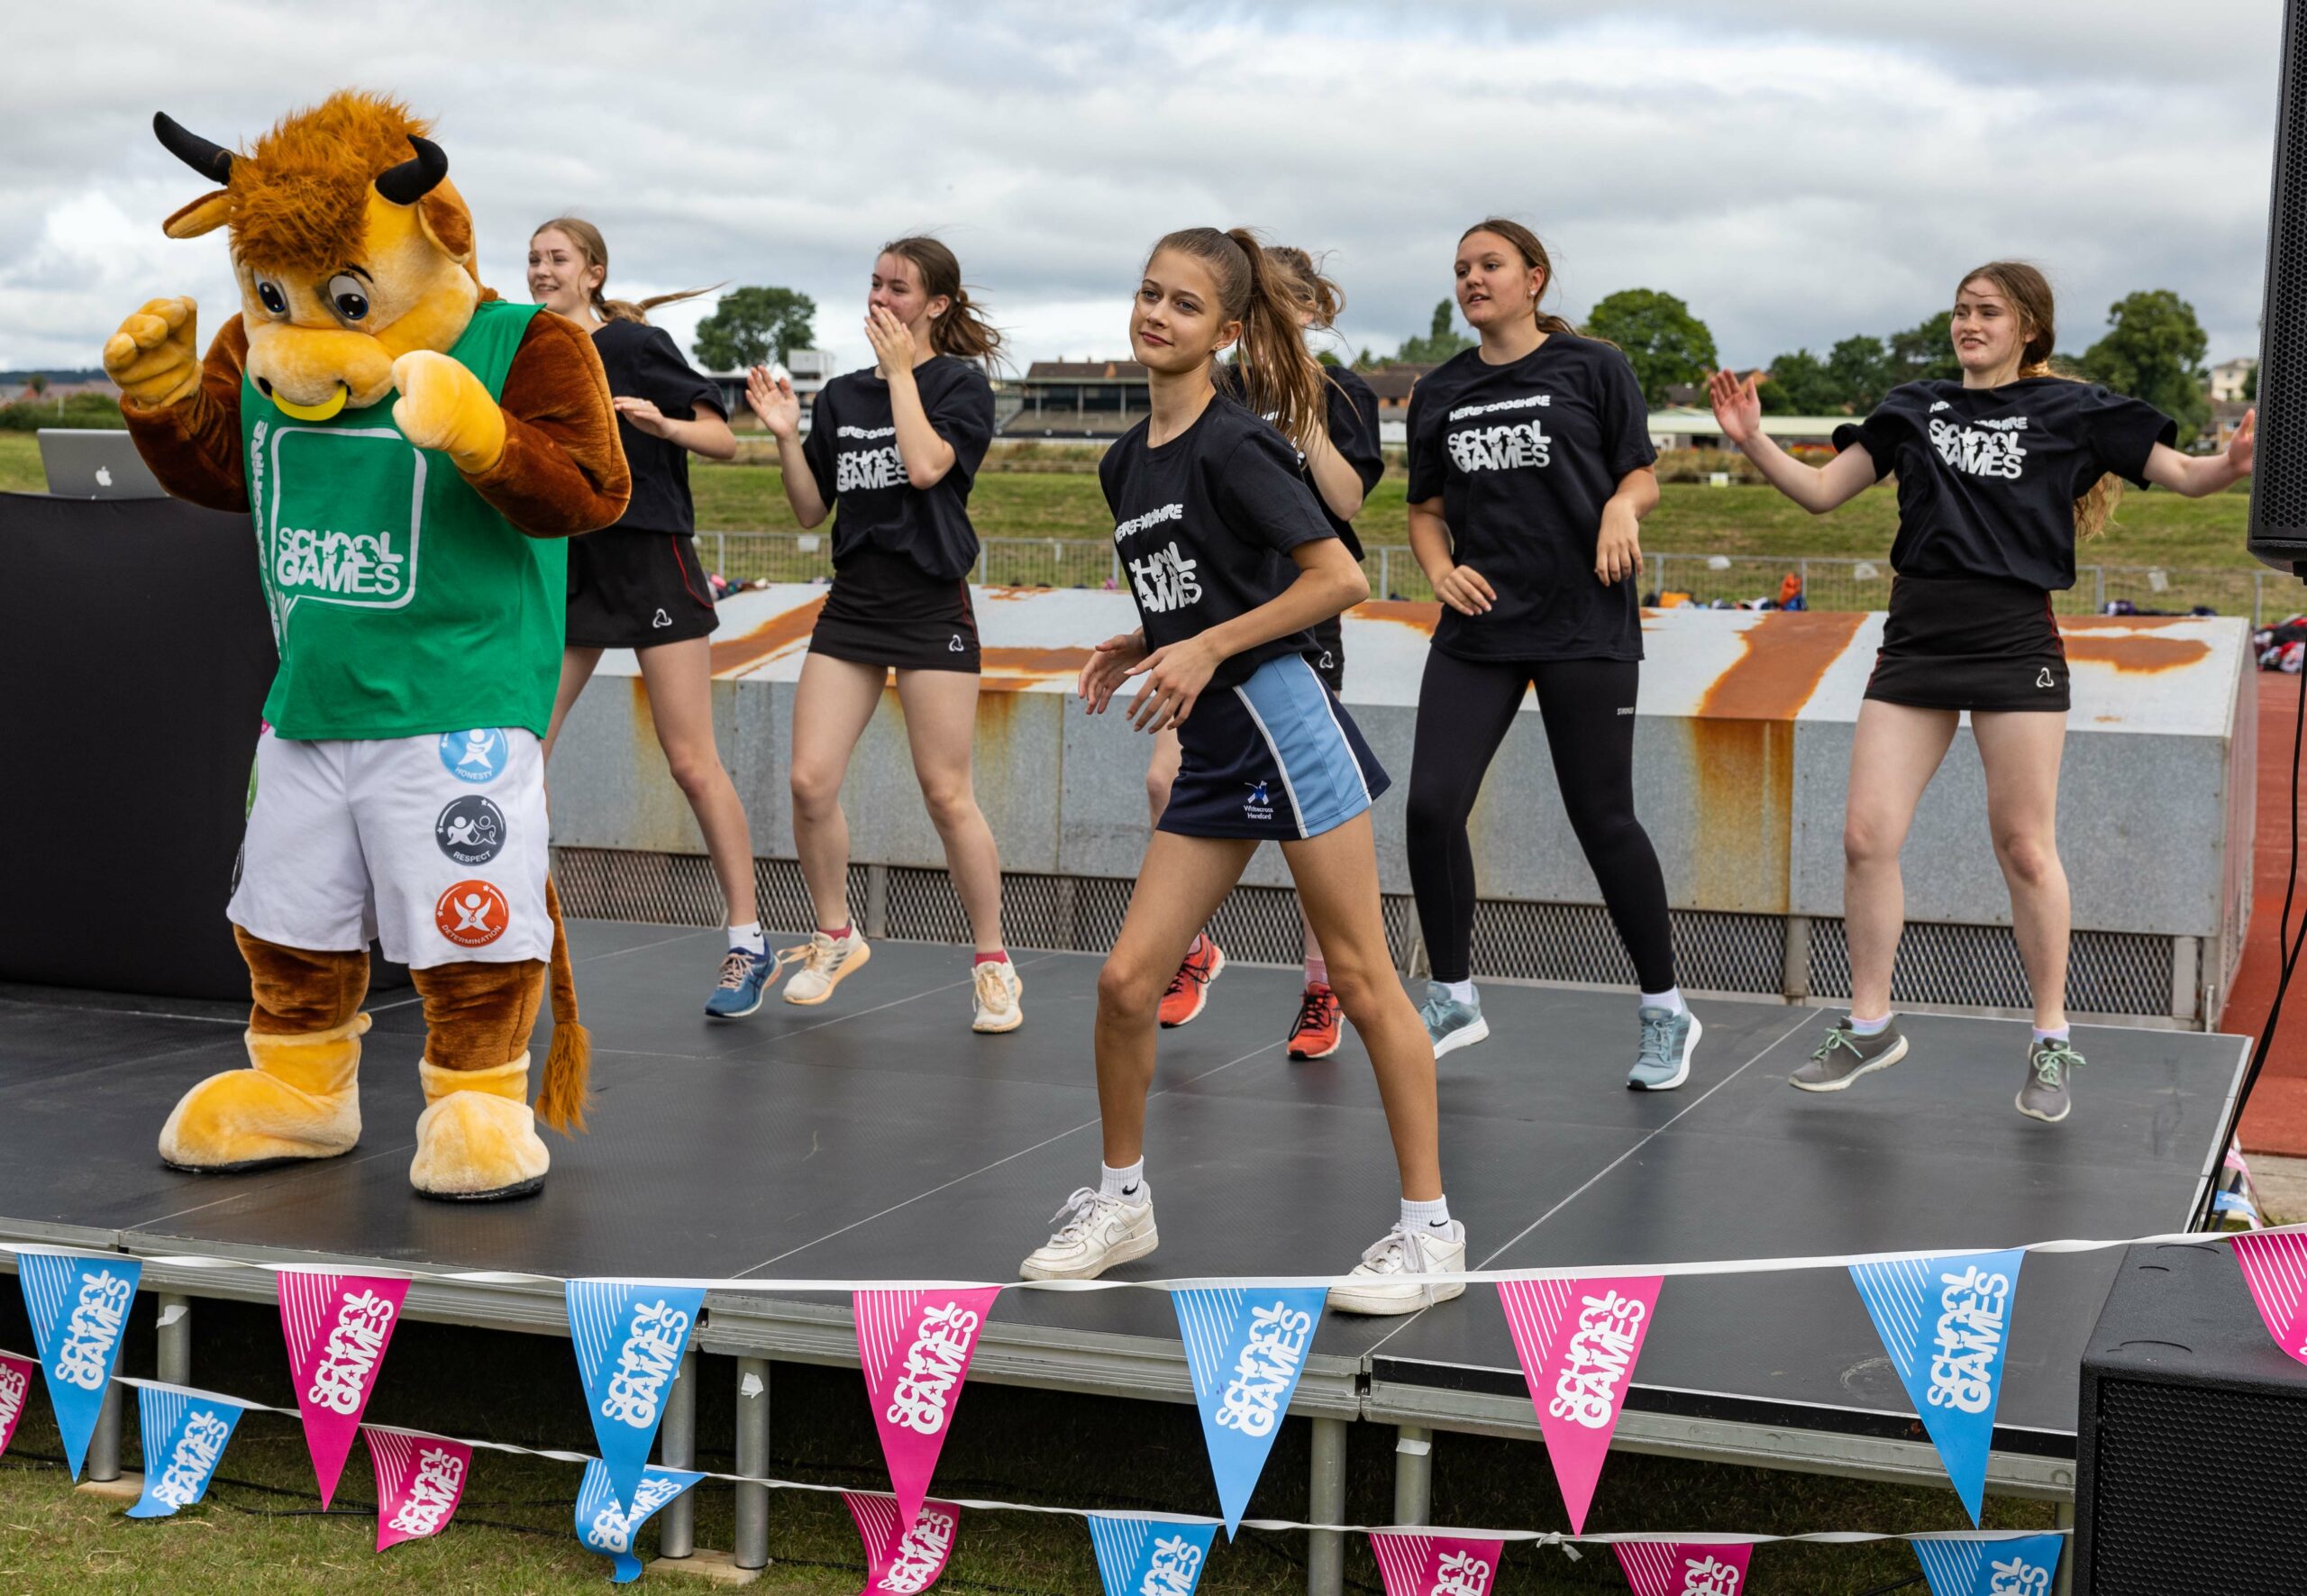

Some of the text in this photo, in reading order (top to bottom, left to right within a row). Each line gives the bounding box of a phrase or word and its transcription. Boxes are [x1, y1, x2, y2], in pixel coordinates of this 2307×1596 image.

[1447, 419, 1552, 453] SCHOOL
[1449, 395, 1551, 422] HEREFORDSHIRE
[1451, 443, 1551, 474] GAMES
[277, 551, 401, 596] GAMES
[278, 527, 404, 564] SCHOOL
[455, 767, 494, 780] HONESTY
[1244, 805, 1273, 813] Whitecross
[453, 851, 492, 862] RESPECT
[442, 924, 502, 944] DETERMINATION
[55, 1269, 109, 1384] SCHOOL
[76, 1276, 131, 1391] GAMES
[308, 1289, 373, 1408] SCHOOL
[329, 1297, 394, 1415] GAMES
[601, 1300, 666, 1421] SCHOOL
[622, 1308, 688, 1429] GAMES
[887, 1301, 955, 1428] SCHOOL
[908, 1307, 979, 1435] GAMES
[1216, 1300, 1284, 1430] SCHOOL
[1239, 1309, 1311, 1437] GAMES
[1549, 1290, 1617, 1422] SCHOOL
[1574, 1297, 1646, 1429] GAMES
[1927, 1265, 1977, 1409] SCHOOL
[1955, 1272, 2010, 1414] GAMES
[152, 1410, 214, 1501] SCHOOL
[167, 1420, 229, 1510] GAMES
[388, 1447, 443, 1531] SCHOOL
[406, 1453, 463, 1536] GAMES
[893, 1512, 953, 1594] GAMES
